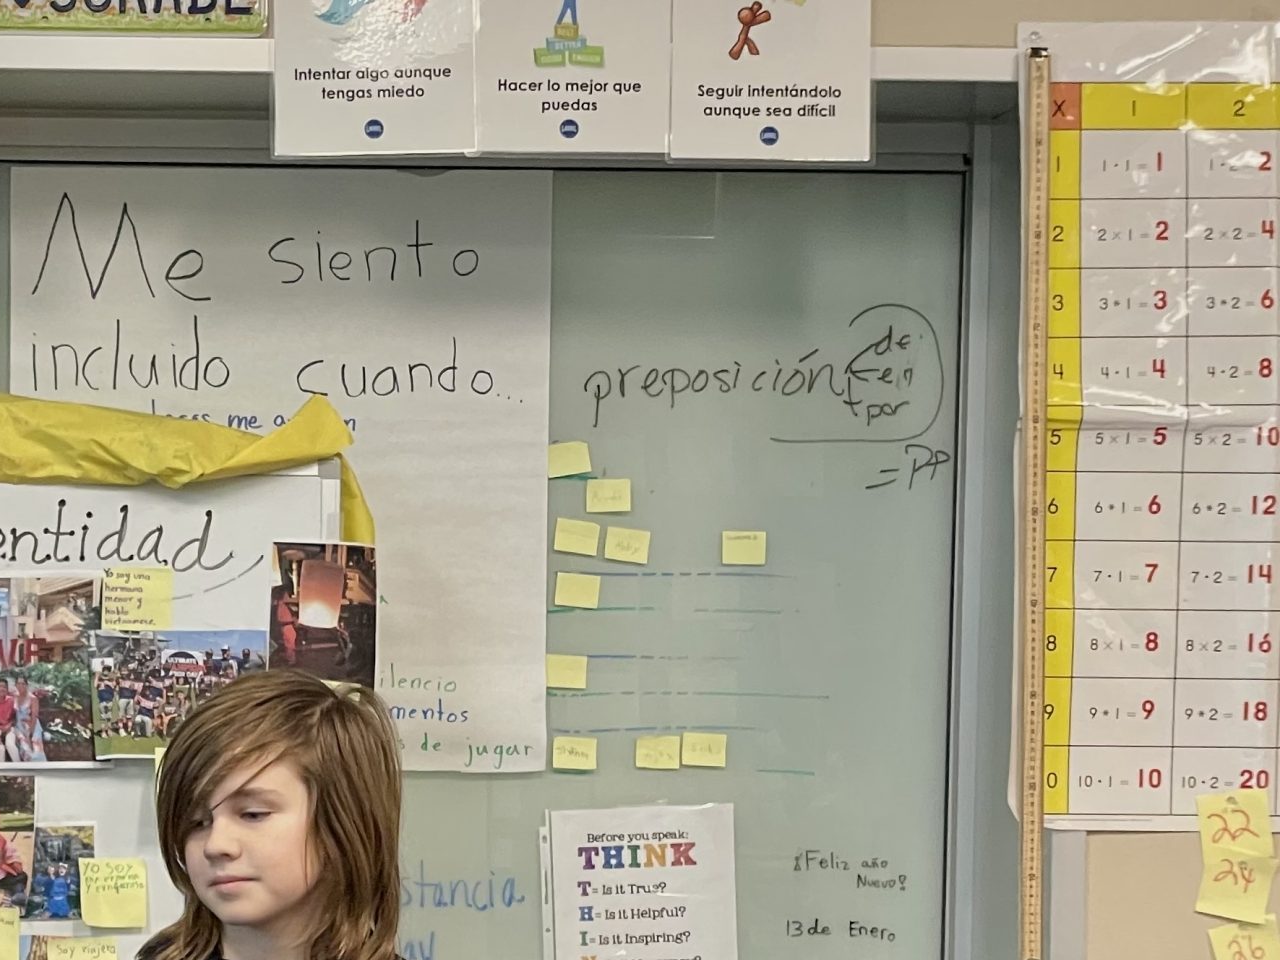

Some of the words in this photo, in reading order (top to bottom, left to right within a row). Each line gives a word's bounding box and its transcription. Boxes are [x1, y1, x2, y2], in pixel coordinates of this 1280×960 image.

[294, 68, 351, 80] Intentar
[356, 67, 389, 82] algo
[394, 67, 451, 80] aunque
[322, 87, 372, 102] tengas
[377, 85, 425, 98] miedo
[498, 79, 543, 91] Hacer
[547, 79, 560, 91] lo
[565, 79, 608, 94] mejor
[613, 82, 641, 94] que
[698, 85, 743, 99] Seguir
[748, 84, 841, 98] intentándolo
[542, 99, 597, 113] puedas
[704, 106, 761, 118] aunque
[766, 106, 792, 116] sea
[797, 104, 835, 117] difícil
[1132, 100, 1136, 117] 1
[1233, 100, 1246, 117] 2
[1156, 152, 1162, 171] 1
[1258, 151, 1272, 171] 2
[1155, 221, 1169, 241] 2
[1261, 220, 1274, 239] 4
[31, 192, 212, 301] Me
[267, 219, 479, 284] siento
[1153, 291, 1168, 310] 3
[1260, 289, 1274, 309] 6
[31, 314, 230, 391] incluido
[1152, 359, 1166, 378] 4
[1258, 358, 1273, 378] 8
[584, 349, 845, 428] preposición
[227, 414, 262, 430] me
[1152, 427, 1168, 446] 5
[1256, 427, 1280, 446] 10
[1148, 495, 1161, 515] 6
[1251, 495, 1277, 515] 12
[104, 568, 113, 578] Yo
[1144, 564, 1159, 583] 7
[1247, 564, 1272, 584] 14
[1145, 632, 1159, 651] 8
[1248, 633, 1272, 653] 16
[1141, 700, 1155, 720] 9
[1243, 701, 1267, 721] 18
[420, 732, 441, 751] de
[464, 737, 535, 769] jugar
[1138, 769, 1162, 789] 10
[1240, 769, 1269, 789] 20
[1207, 809, 1260, 843] 22
[587, 832, 624, 843] Before
[627, 831, 649, 843] you
[652, 830, 689, 841] speak:
[577, 842, 697, 870] THINK
[861, 857, 889, 869] año
[602, 884, 613, 895] Is
[615, 883, 625, 894] it
[627, 882, 667, 894] True?
[856, 874, 907, 891] Nuevo!
[604, 909, 616, 920] Is
[618, 908, 629, 919] it
[631, 906, 686, 921] Helpful?
[598, 934, 610, 945] Is
[612, 933, 623, 944] it
[625, 931, 691, 945] Inspiring?
[786, 920, 803, 937] 13
[807, 918, 831, 935] de
[849, 920, 896, 942] Enero
